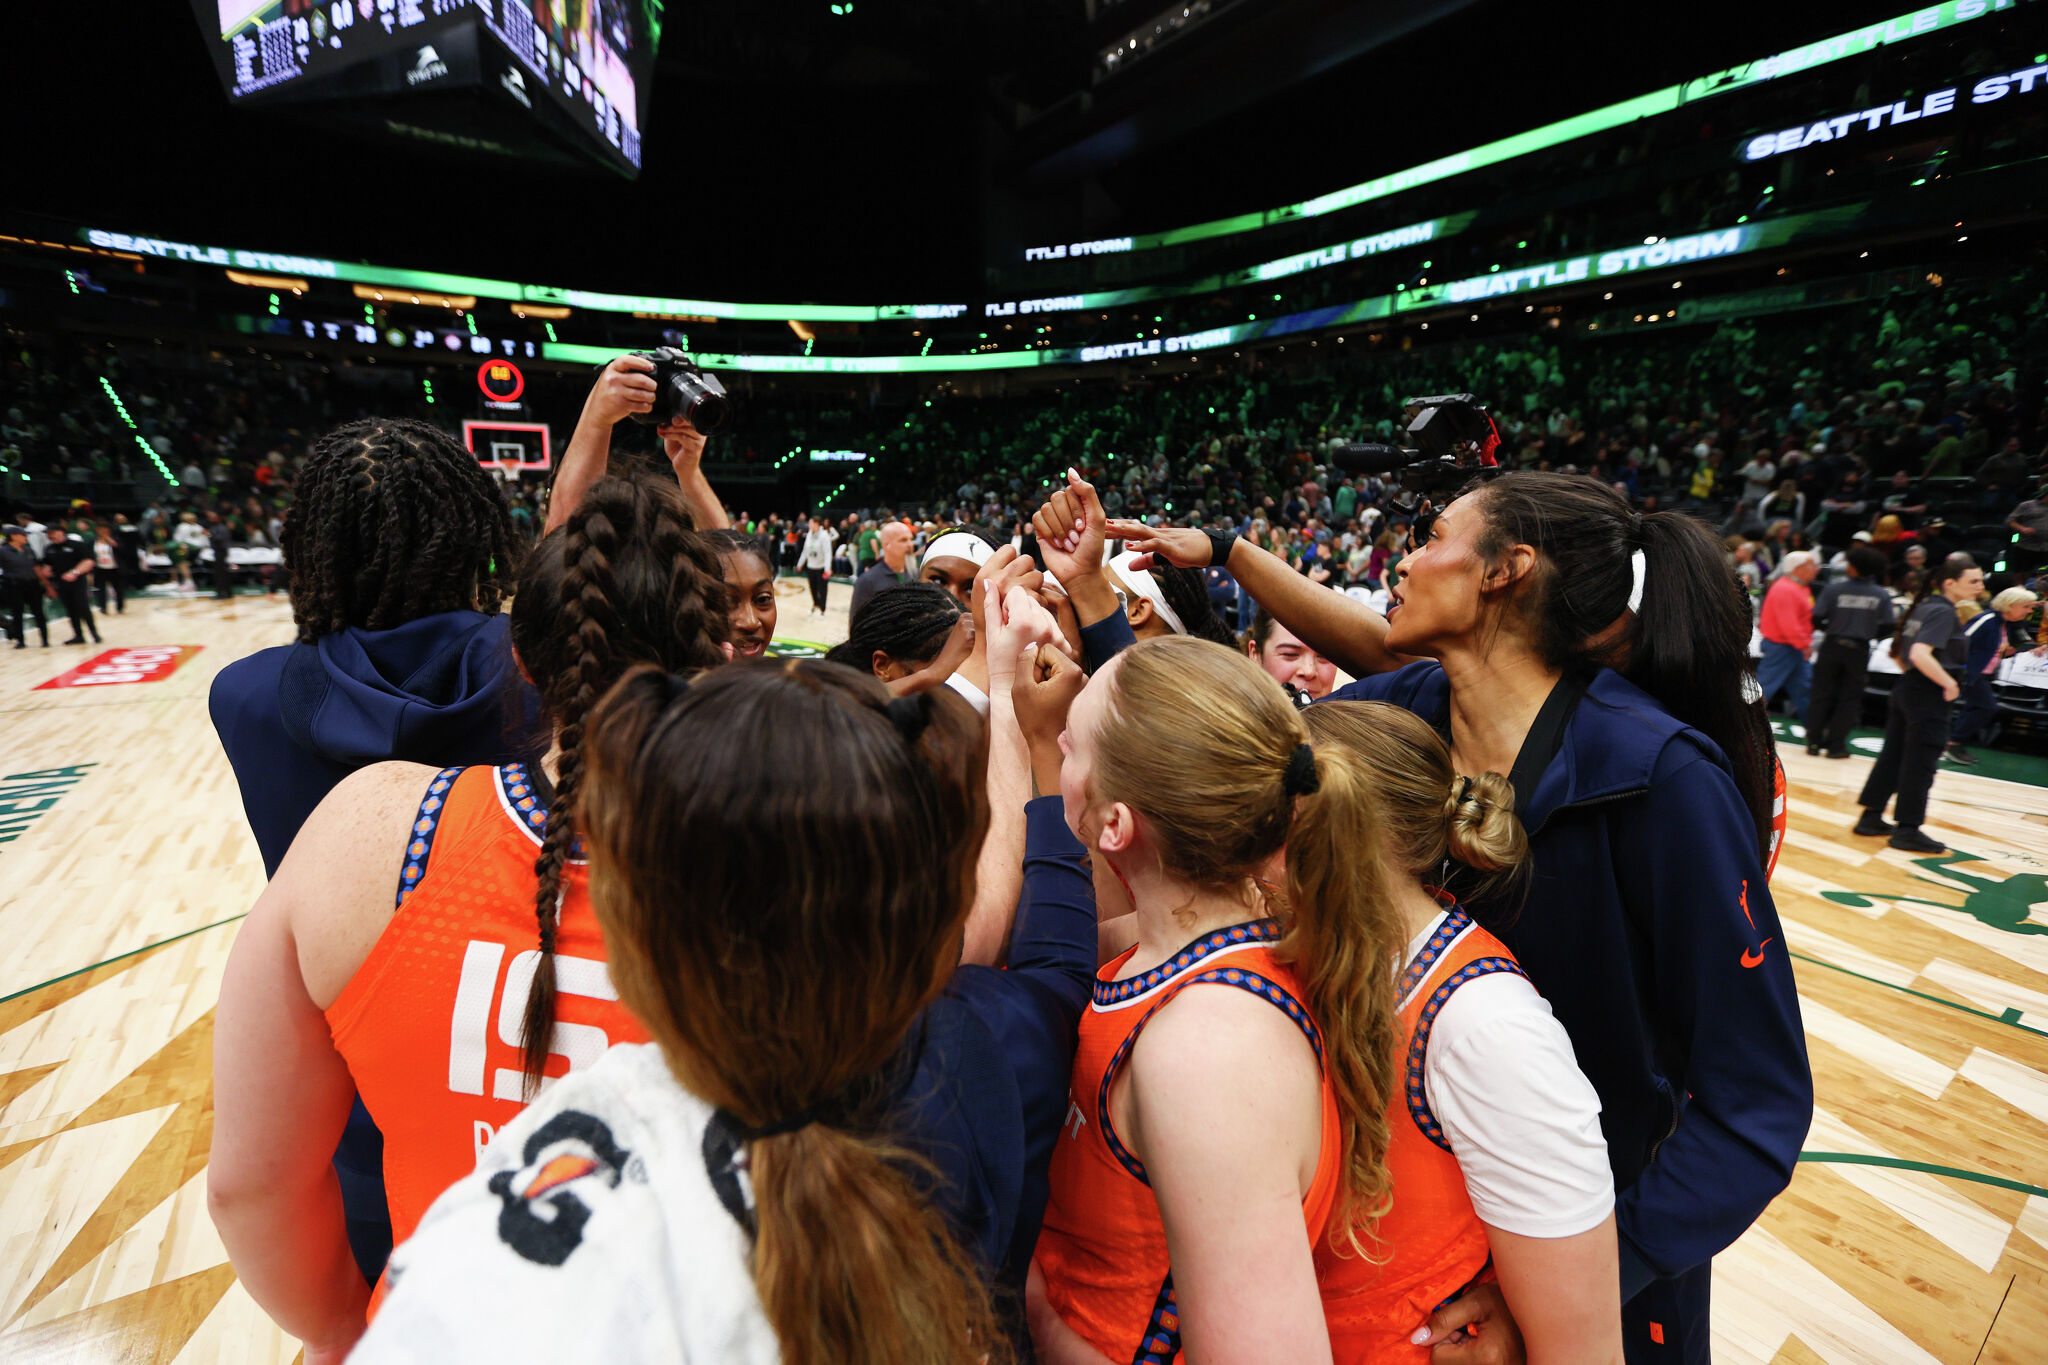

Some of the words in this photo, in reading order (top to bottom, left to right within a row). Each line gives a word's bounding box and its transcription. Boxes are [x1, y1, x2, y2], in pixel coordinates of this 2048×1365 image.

[1757, 7, 1941, 79] SEATTLE
[1746, 87, 1958, 161] SEATTLE
[1971, 64, 2048, 104] ST
[89, 230, 230, 265] SEATTLE
[235, 250, 336, 278] STORM
[1069, 237, 1132, 257] STORM
[1259, 244, 1347, 280] SEATTLE
[1351, 221, 1434, 258] STORM
[1450, 257, 1590, 302] SEATTLE
[1598, 228, 1740, 275] STORM
[1019, 294, 1083, 315] STORM
[1081, 339, 1161, 362] SEATTLE
[1165, 327, 1231, 353] STORM
[448, 939, 620, 1105] 15
